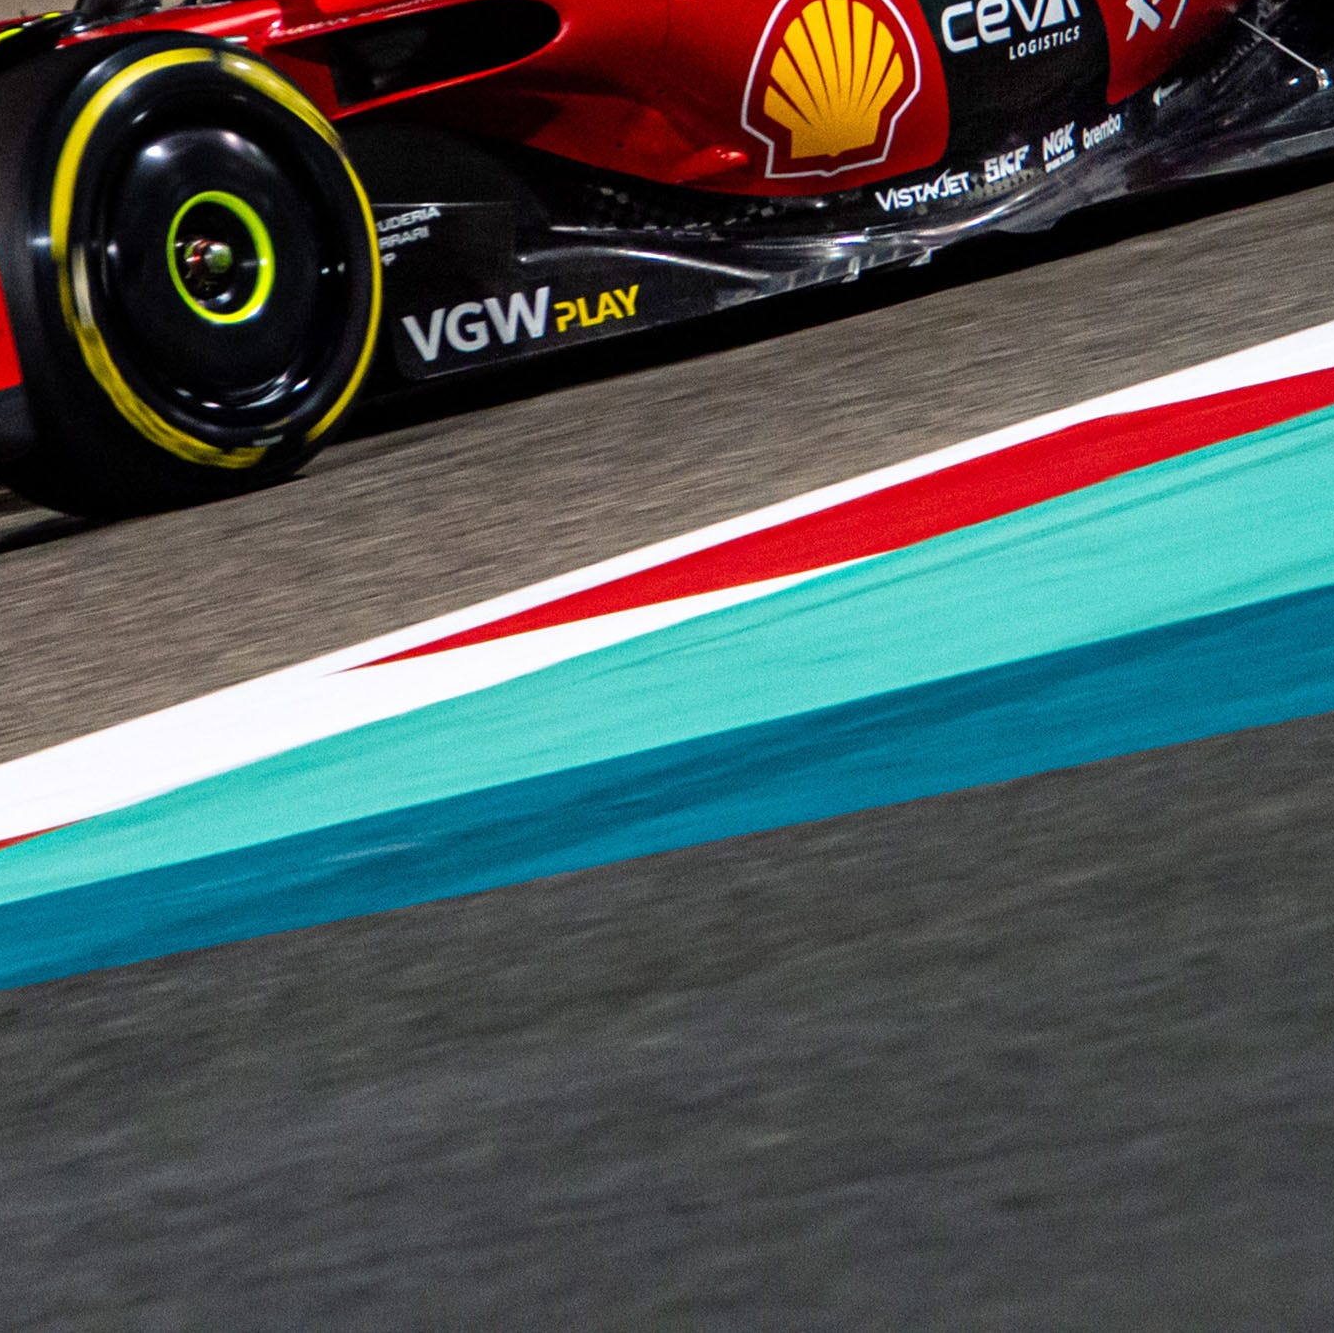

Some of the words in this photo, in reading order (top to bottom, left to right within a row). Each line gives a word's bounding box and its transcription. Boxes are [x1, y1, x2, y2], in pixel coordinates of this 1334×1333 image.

[1009, 25, 1081, 60] LOGISTICS
[1042, 121, 1075, 161] NGK
[1081, 113, 1123, 150] brembo
[983, 144, 1031, 184] SKF
[375, 206, 442, 233] UDERIA
[378, 226, 430, 251] RRARI
[401, 286, 550, 361] VGW
[554, 284, 640, 334] PLAY
